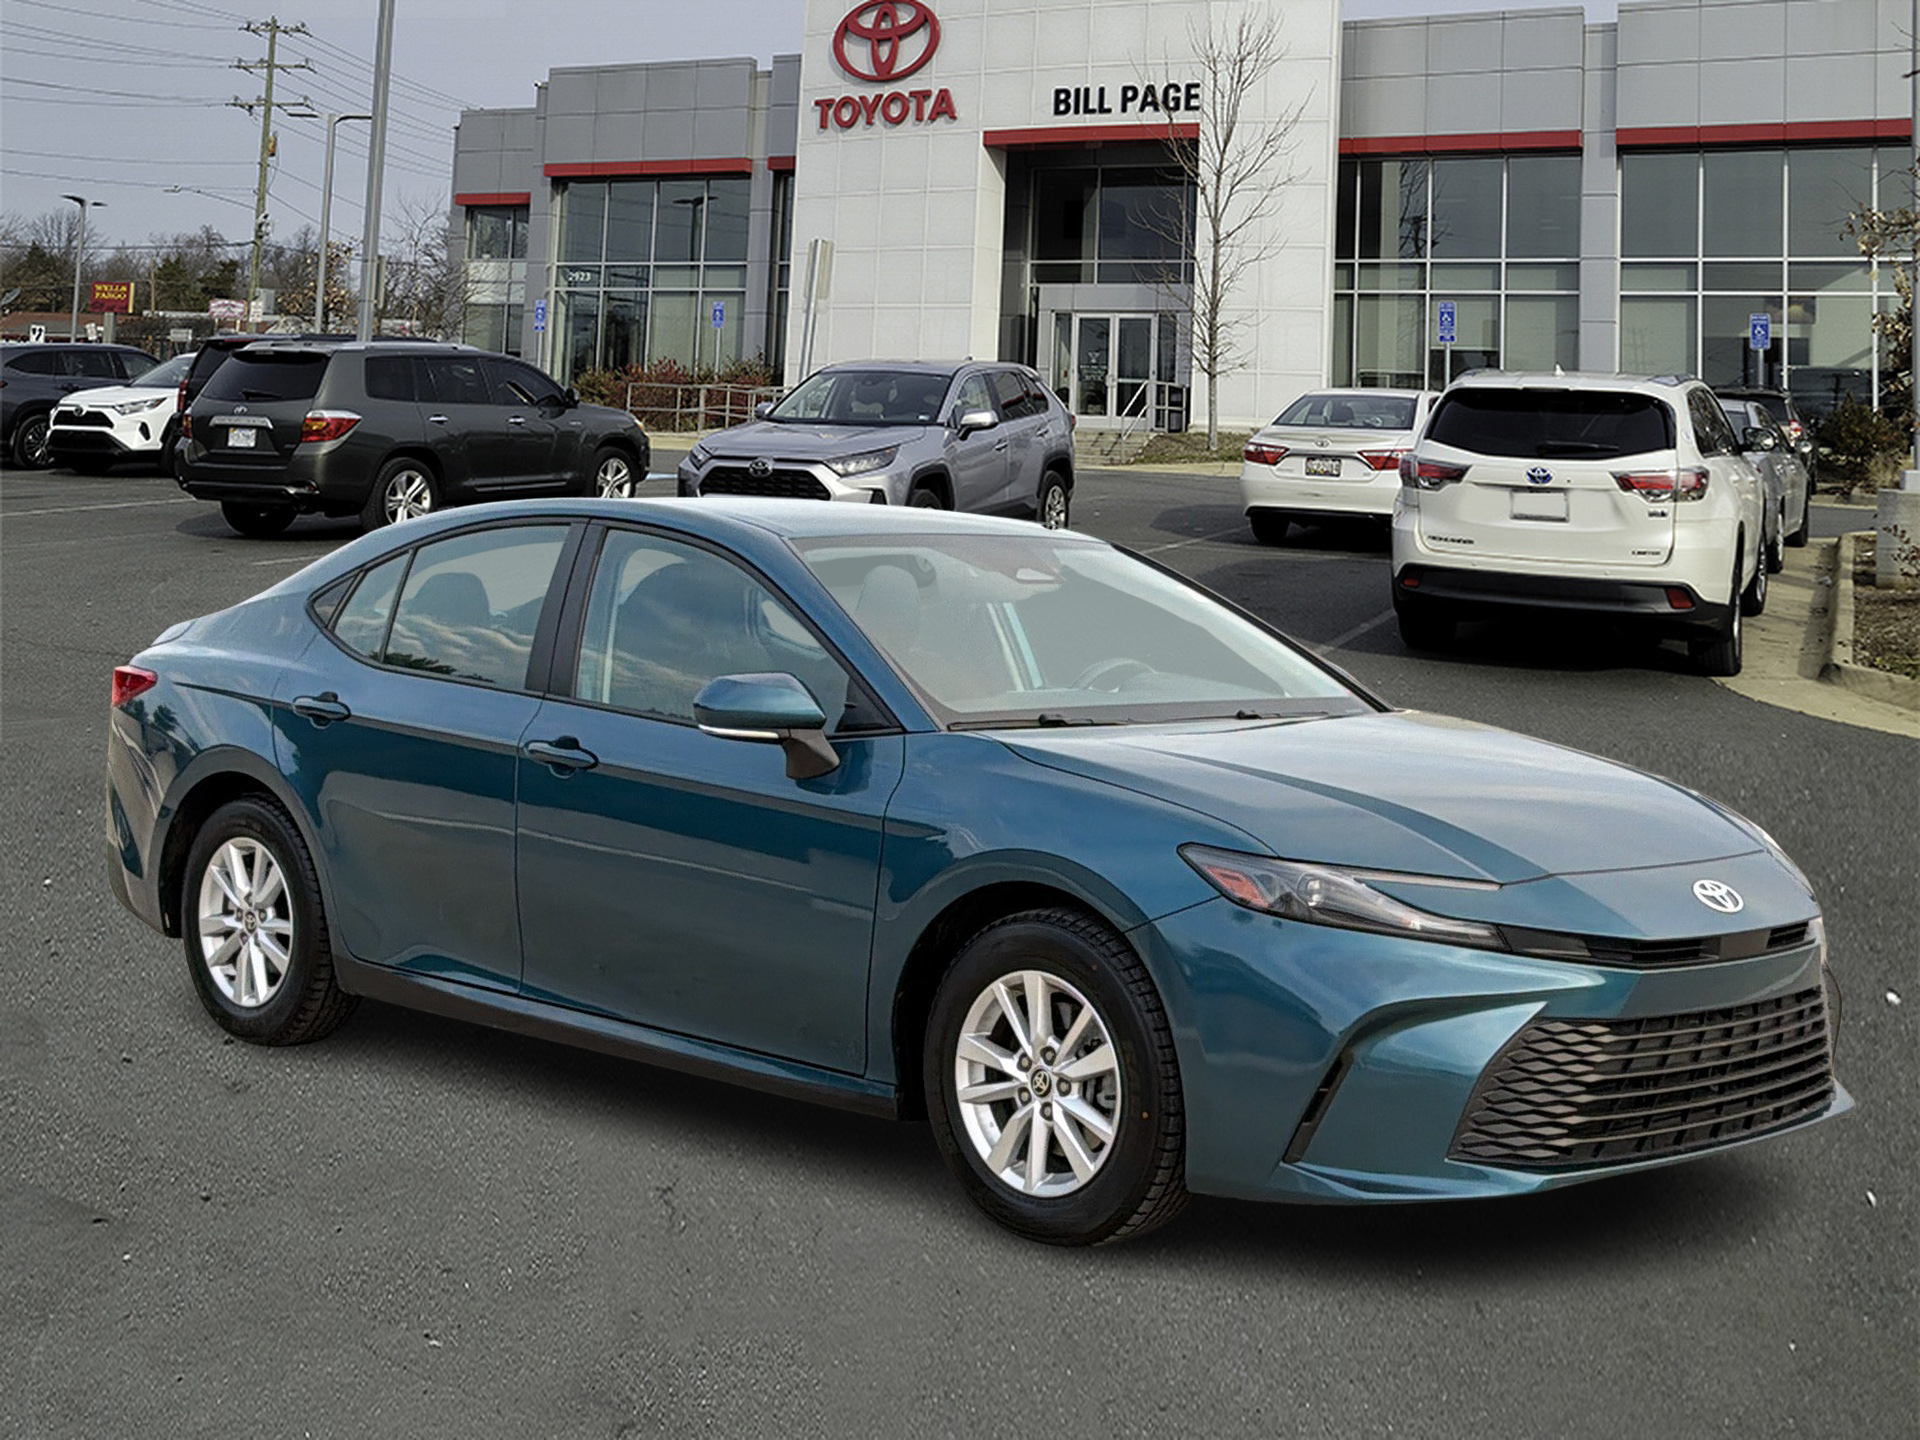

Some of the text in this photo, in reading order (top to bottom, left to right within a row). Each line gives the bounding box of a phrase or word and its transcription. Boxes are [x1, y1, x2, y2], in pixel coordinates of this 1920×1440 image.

[814, 88, 958, 129] TOYOTA
[1053, 82, 1201, 116] BILL PAGE
[95, 291, 127, 299] FARGO
